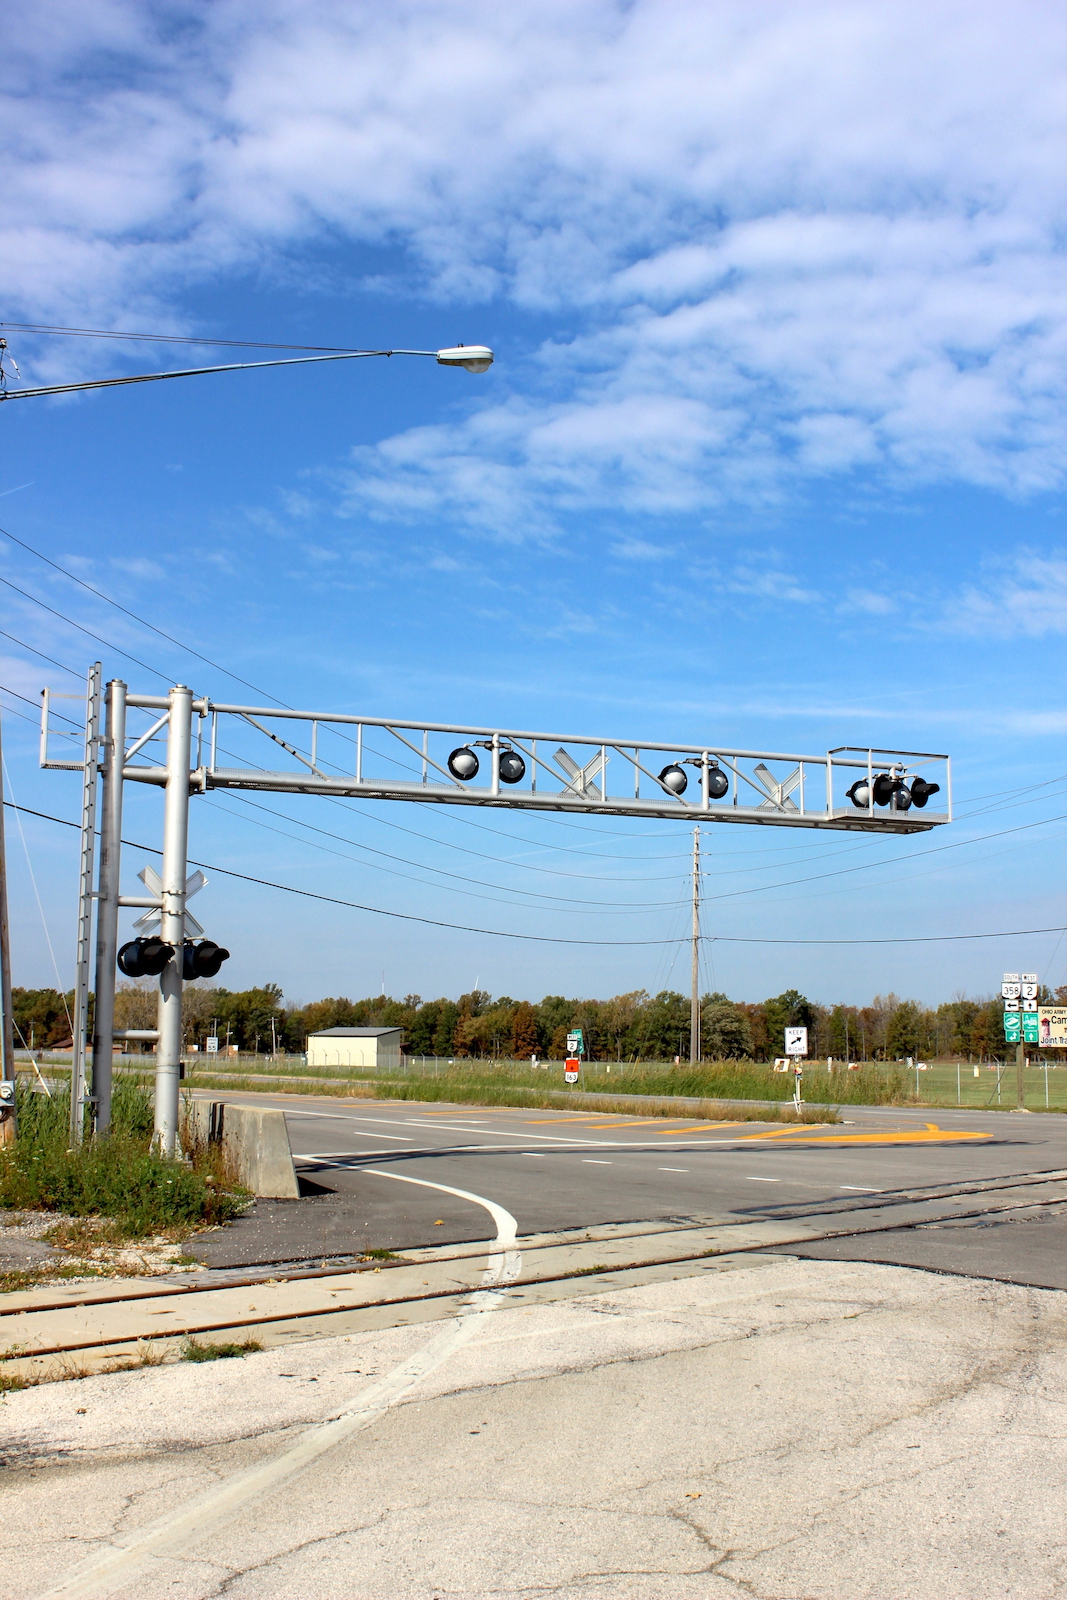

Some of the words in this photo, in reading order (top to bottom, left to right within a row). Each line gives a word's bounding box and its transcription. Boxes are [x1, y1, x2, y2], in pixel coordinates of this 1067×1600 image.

[1004, 986, 1020, 995] 358
[1027, 986, 1033, 996] 2
[1040, 1036, 1058, 1044] Joint
[569, 1042, 575, 1050] 2
